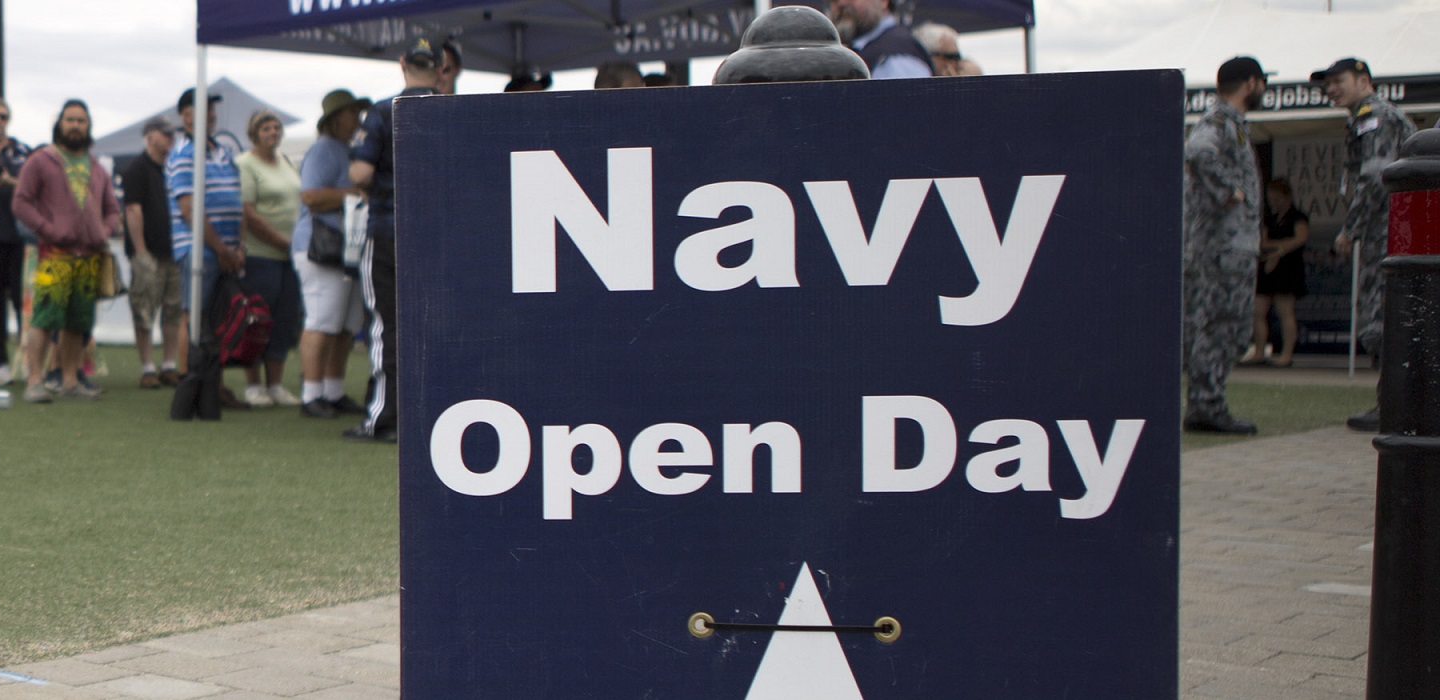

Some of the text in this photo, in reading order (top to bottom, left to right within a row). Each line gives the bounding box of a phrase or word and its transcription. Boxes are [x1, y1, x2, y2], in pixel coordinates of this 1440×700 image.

[510, 146, 1066, 326] Navy
[430, 395, 1146, 520] Open Day
